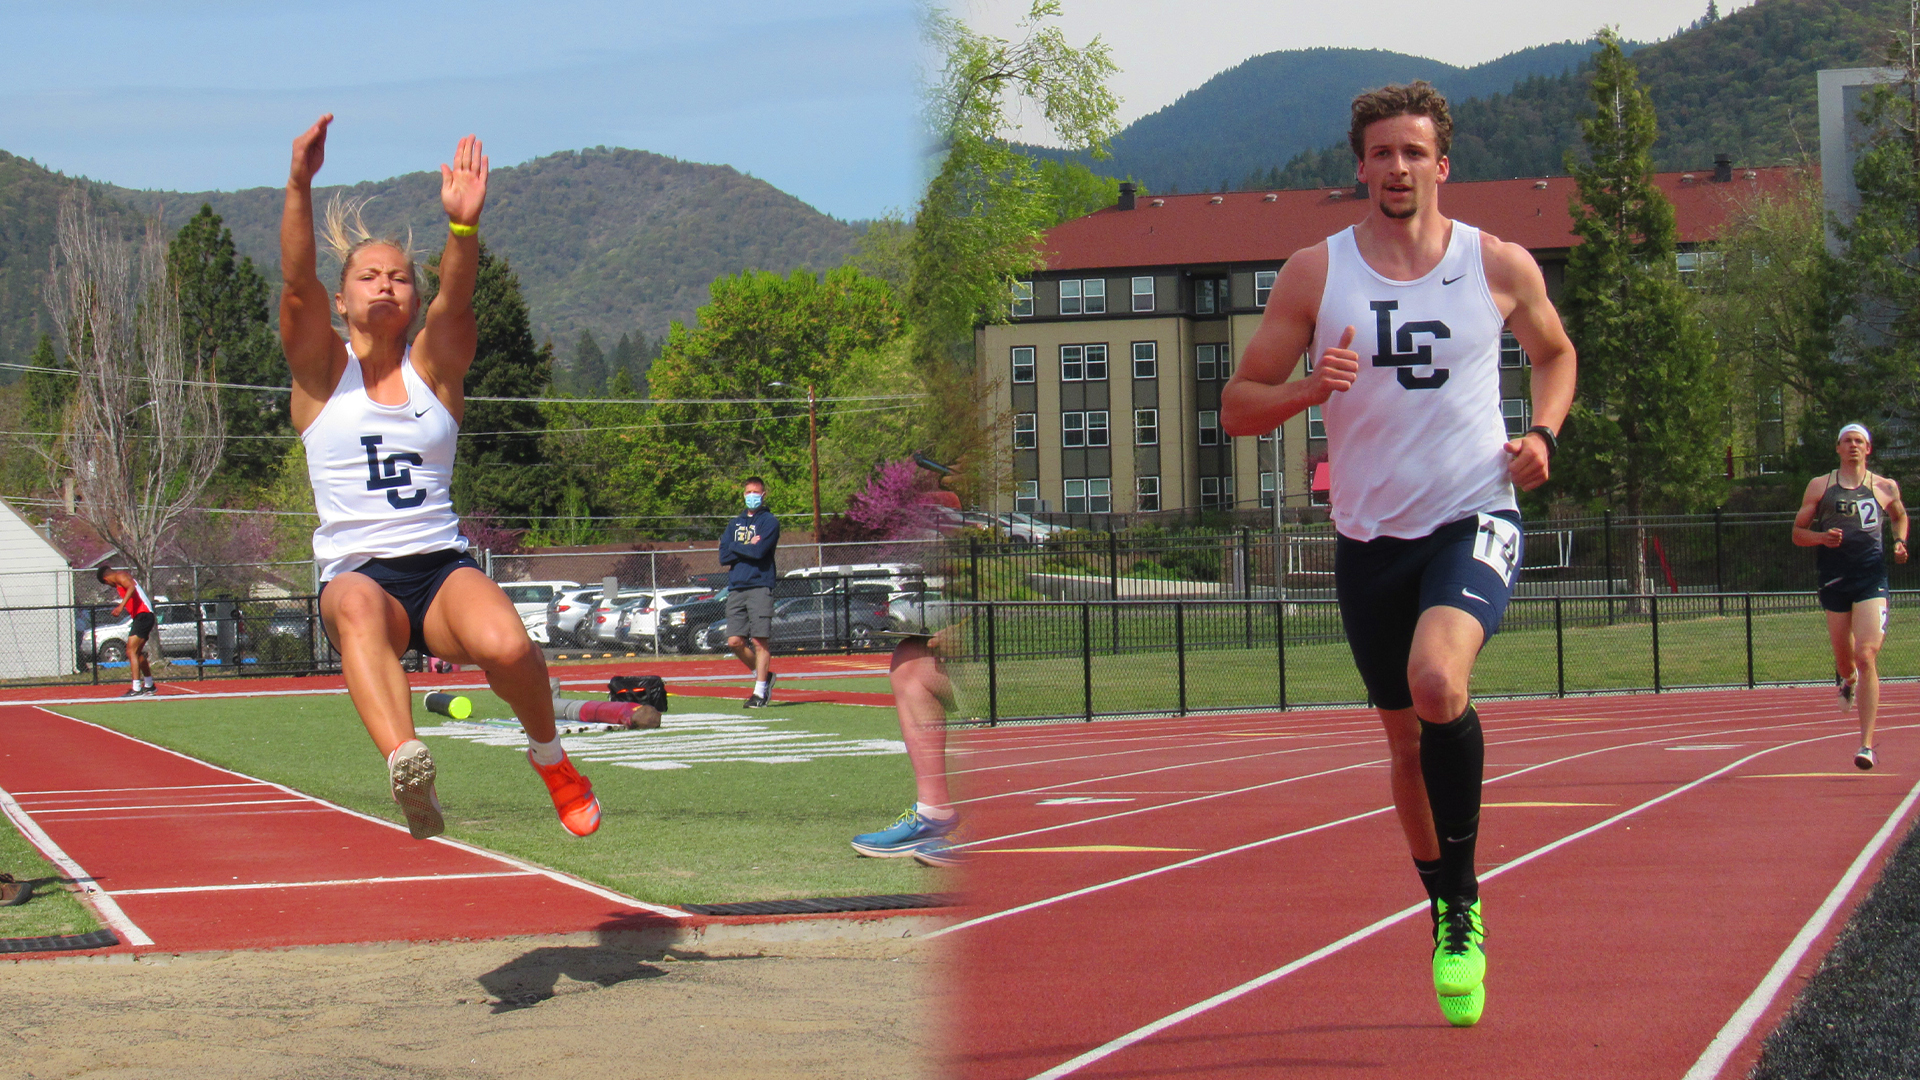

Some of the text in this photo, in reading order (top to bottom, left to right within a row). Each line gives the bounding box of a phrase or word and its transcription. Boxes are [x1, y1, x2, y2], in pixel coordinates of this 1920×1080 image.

[1369, 300, 1451, 390] LC
[360, 435, 427, 509] LC
[1861, 502, 1876, 525] 2
[1478, 519, 1517, 577] 14
